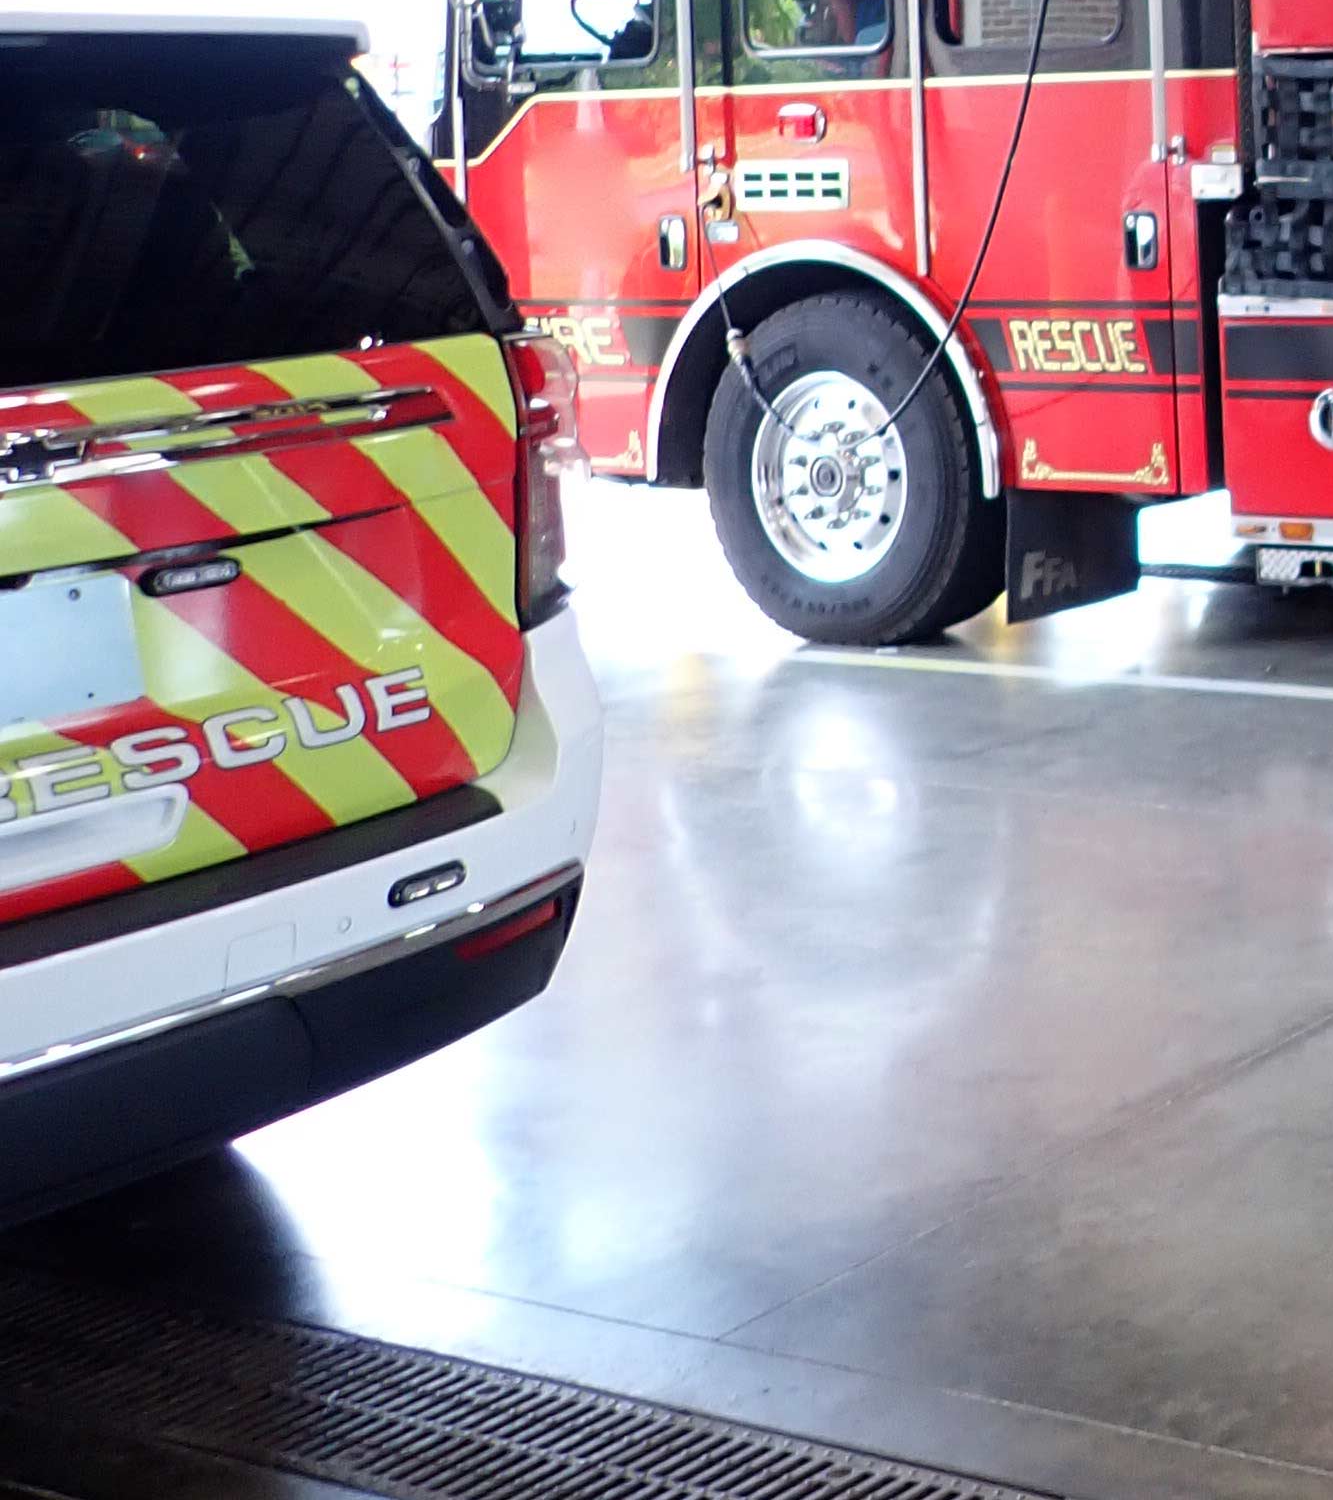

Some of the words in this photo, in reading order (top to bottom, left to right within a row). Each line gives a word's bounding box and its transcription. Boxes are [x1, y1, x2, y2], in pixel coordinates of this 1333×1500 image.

[525, 316, 626, 366] RE
[1009, 319, 1146, 373] RESCUE
[1020, 549, 1078, 600] FFA
[0, 665, 432, 822] ESCUE
